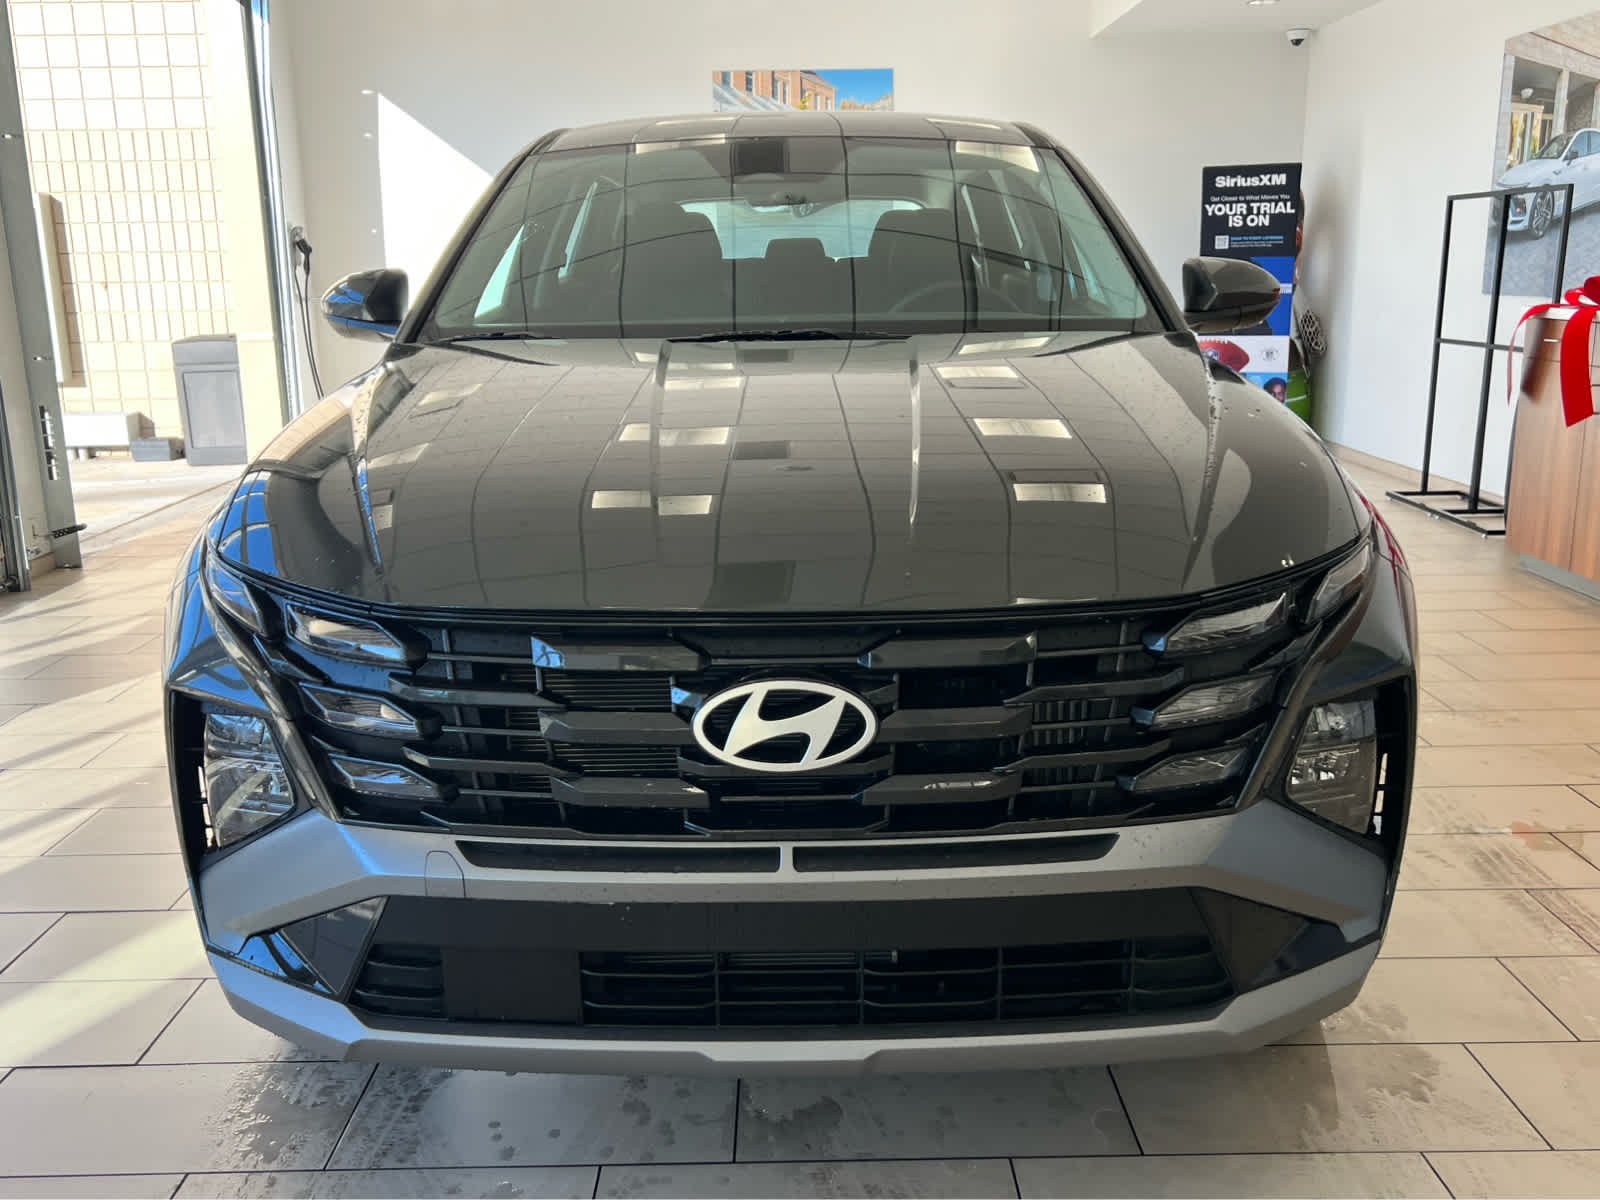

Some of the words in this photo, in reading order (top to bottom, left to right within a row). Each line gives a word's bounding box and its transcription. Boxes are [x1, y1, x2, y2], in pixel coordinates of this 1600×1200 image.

[1215, 173, 1287, 188] SiriusXM
[1204, 202, 1247, 216] YOUR
[1250, 201, 1295, 214] TRIAL
[1228, 215, 1243, 228] IS
[1246, 214, 1270, 227] ON
